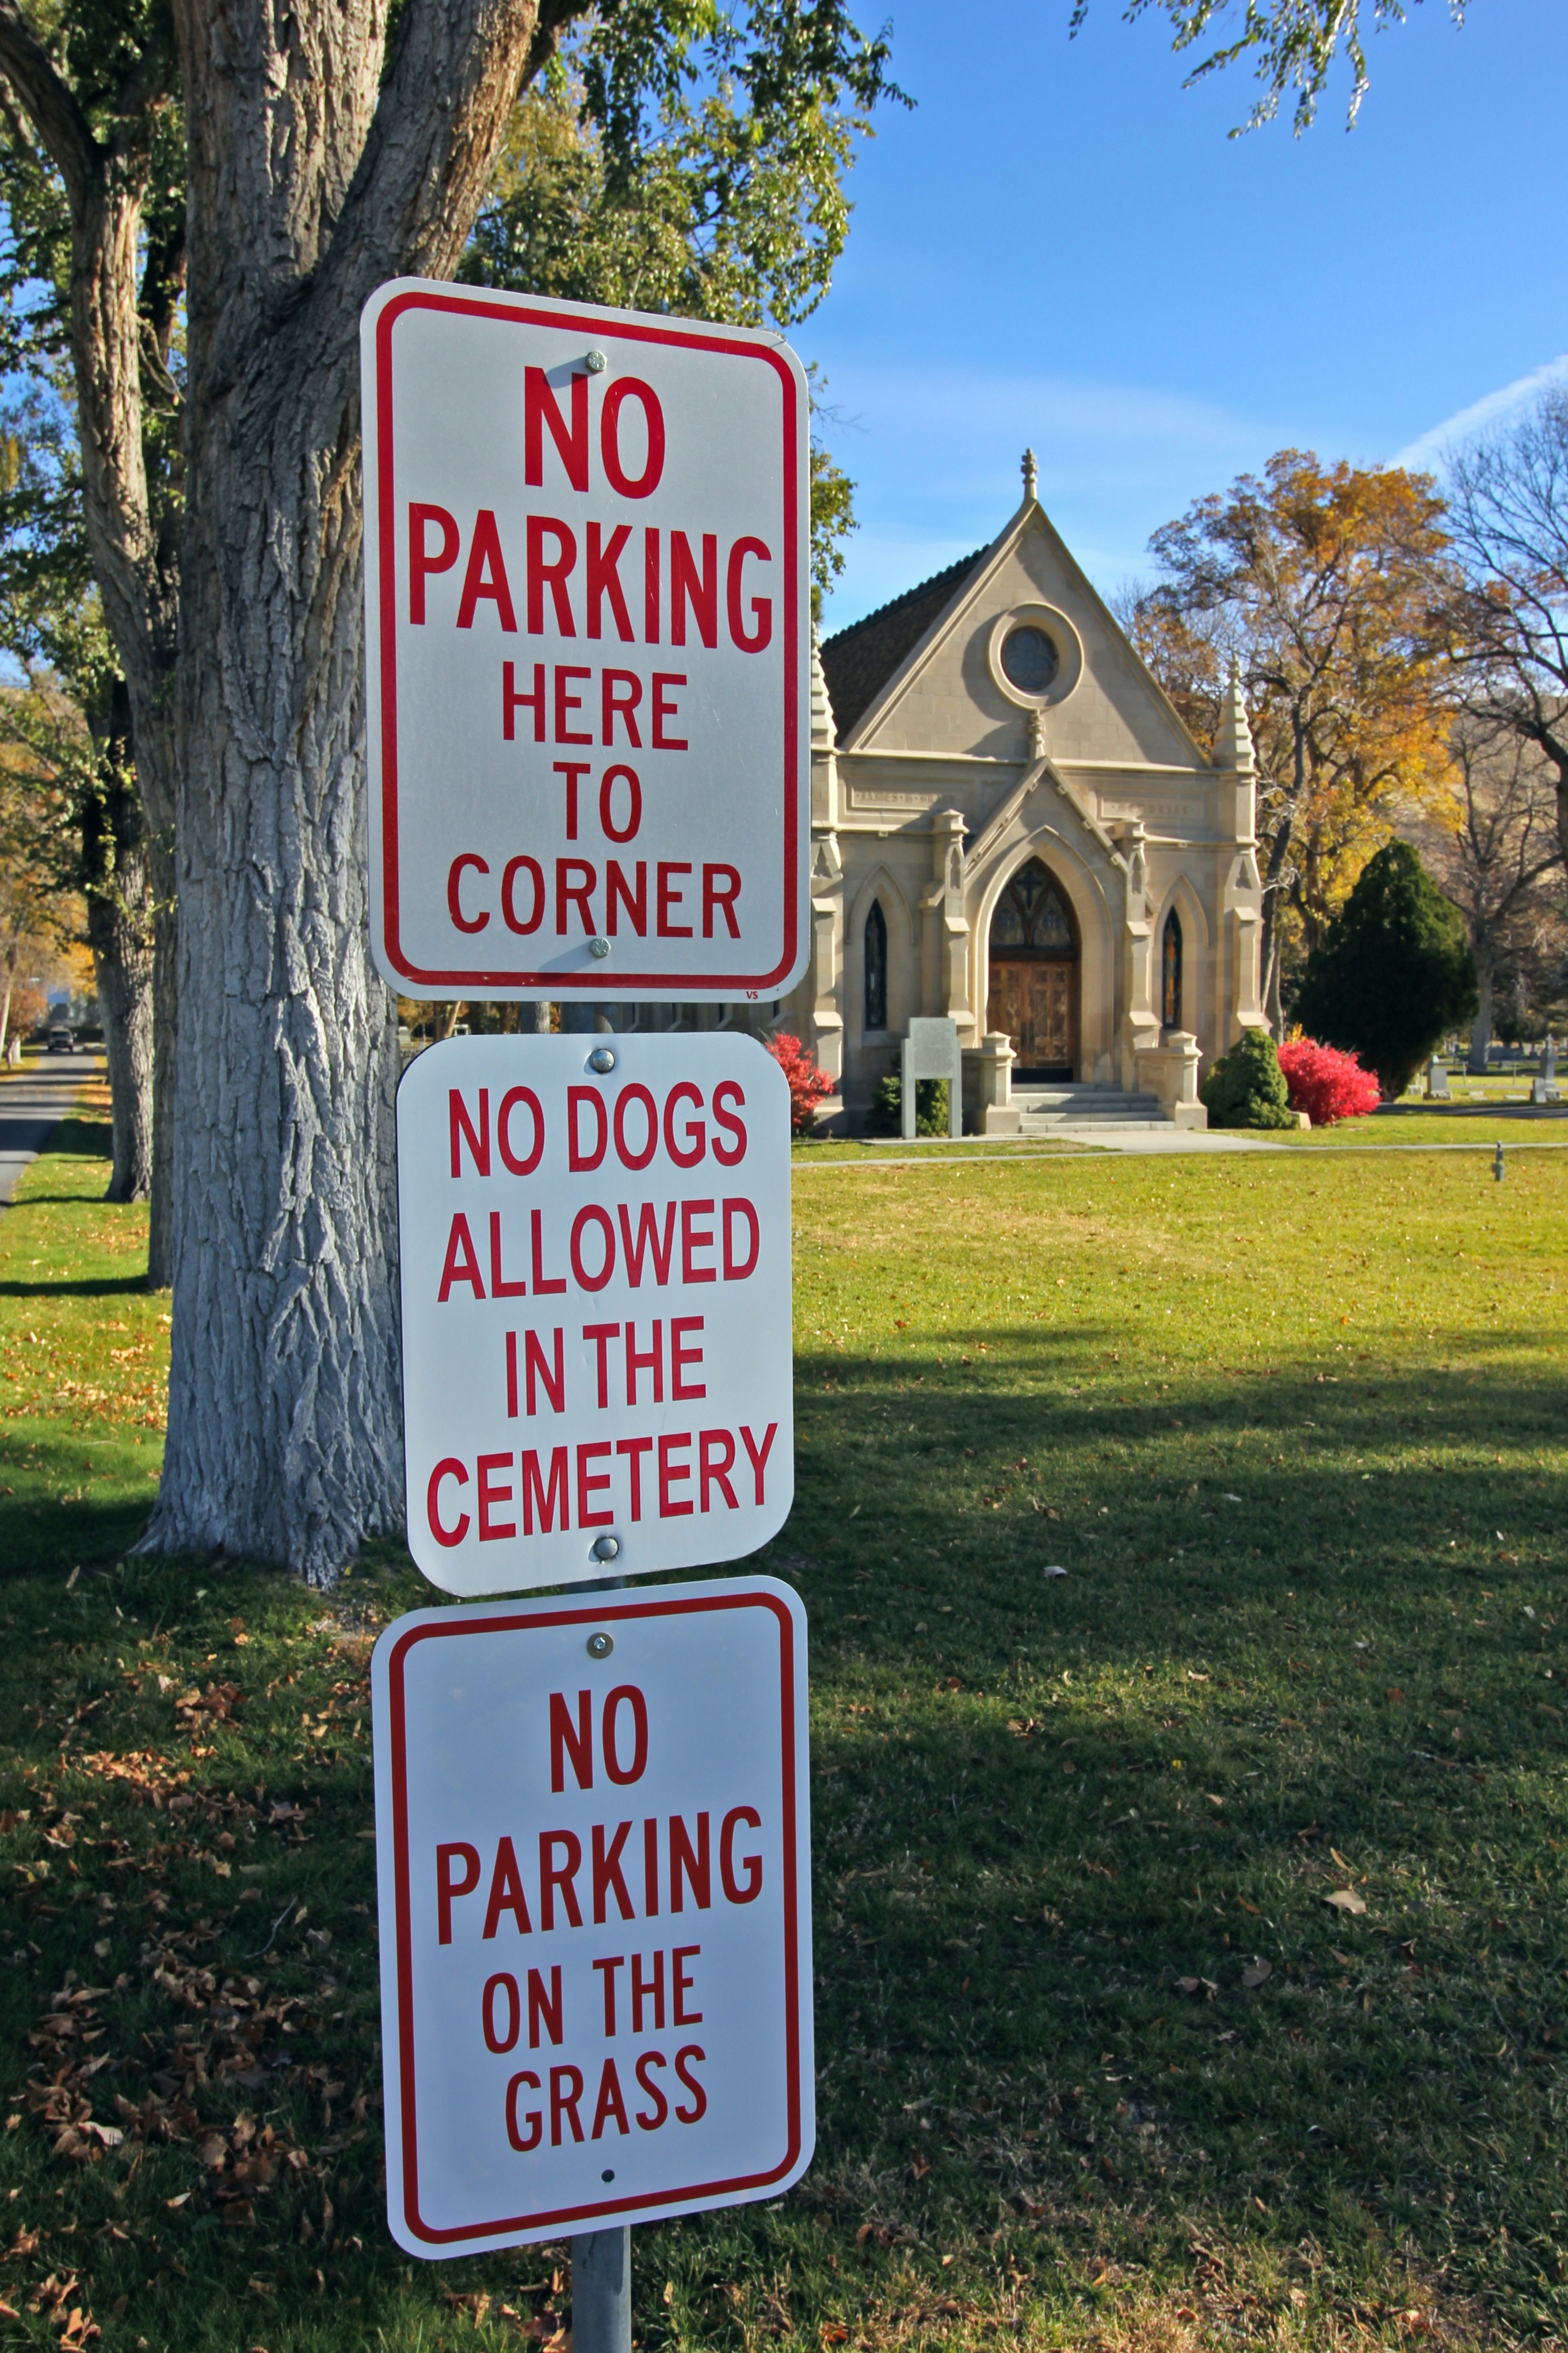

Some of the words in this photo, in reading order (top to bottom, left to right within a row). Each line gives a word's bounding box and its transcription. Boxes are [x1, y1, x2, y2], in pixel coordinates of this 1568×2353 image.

[524, 365, 665, 499] NO
[408, 501, 772, 653] PARKING
[502, 660, 688, 751] HERE
[553, 761, 642, 843] TO
[447, 852, 742, 939] CORNER
[746, 991, 758, 999] VS
[449, 1086, 544, 1178] NO
[567, 1080, 747, 1172] DOGS
[437, 1197, 760, 1303] ALLOWED
[505, 1327, 564, 1418] IN
[582, 1316, 707, 1408] THE
[427, 1422, 778, 1548] CEMETERY
[550, 1685, 648, 1793] NO
[436, 1806, 762, 1945] PARKING
[482, 1966, 563, 2054] ON
[593, 1945, 703, 2036] THE
[506, 2045, 707, 2152] GRASS
